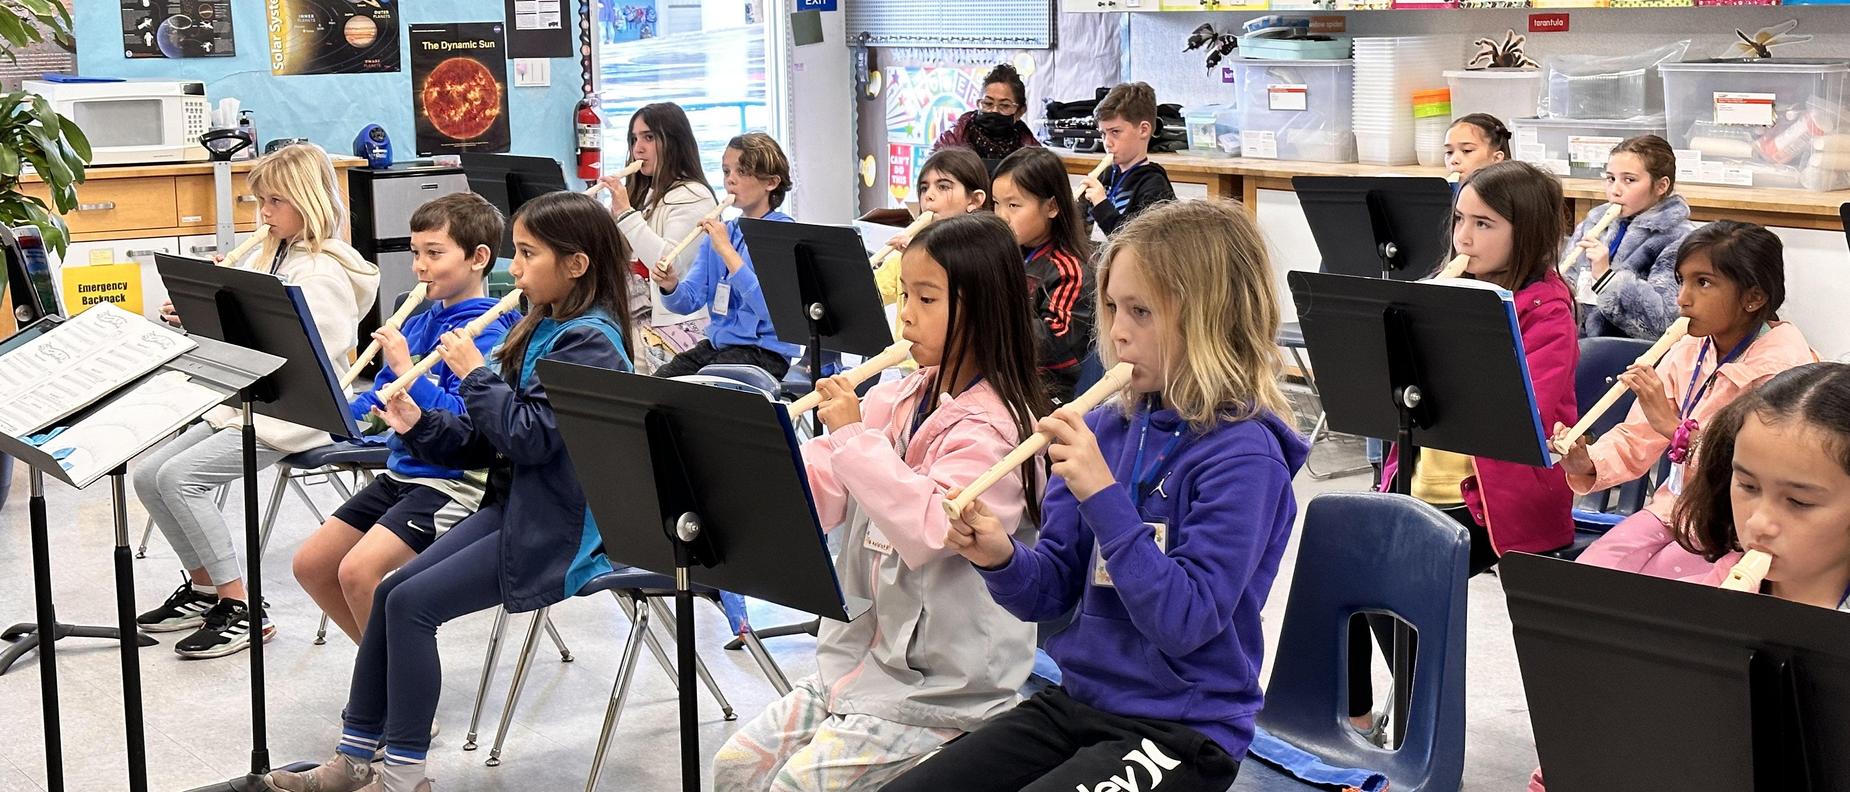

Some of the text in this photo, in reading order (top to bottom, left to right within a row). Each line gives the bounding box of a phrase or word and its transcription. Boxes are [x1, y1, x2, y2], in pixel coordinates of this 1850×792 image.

[1534, 19, 1564, 27] tarantula
[422, 40, 495, 51] The Dynamic Sun
[271, 34, 284, 70] Solar
[890, 156, 910, 165] CAN'T
[894, 165, 905, 174] DO
[891, 175, 907, 185] THIS
[78, 281, 128, 293] Emergency
